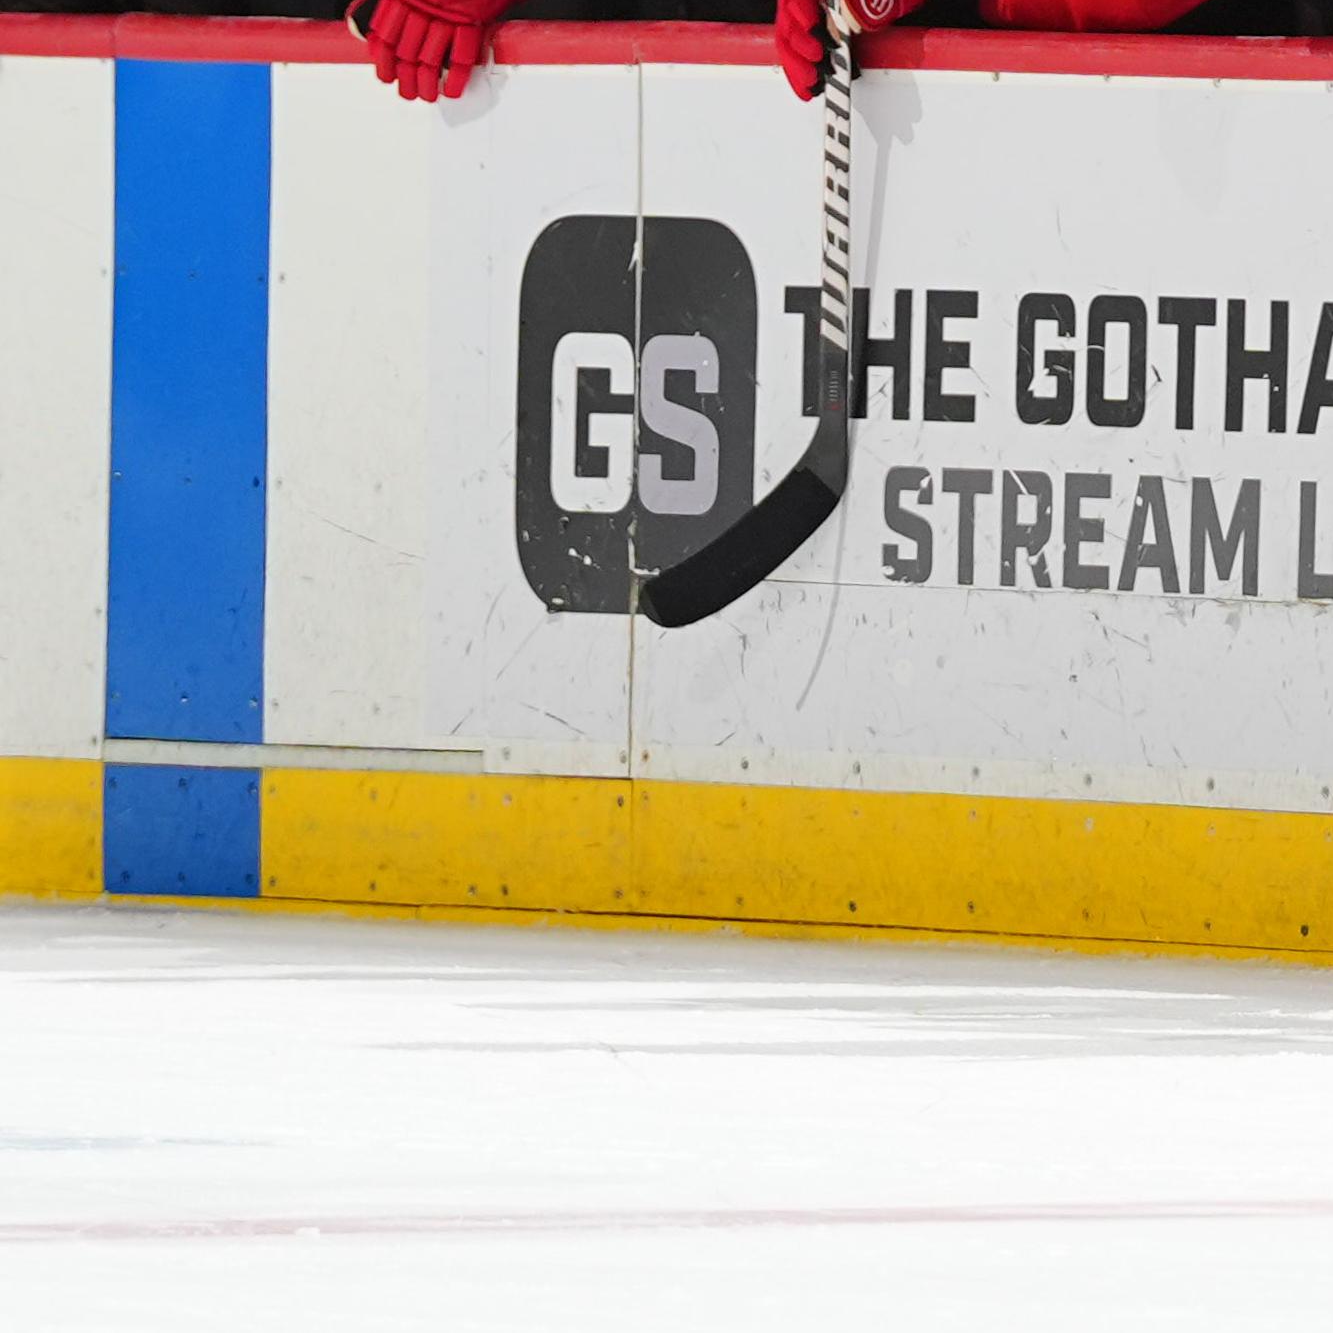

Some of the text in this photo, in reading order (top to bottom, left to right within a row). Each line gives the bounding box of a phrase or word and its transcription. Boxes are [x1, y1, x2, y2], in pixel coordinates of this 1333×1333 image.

[819, 69, 851, 352] WARRI
[550, 331, 719, 515] GS
[783, 285, 979, 423] THE
[882, 465, 1261, 598] STREAM
